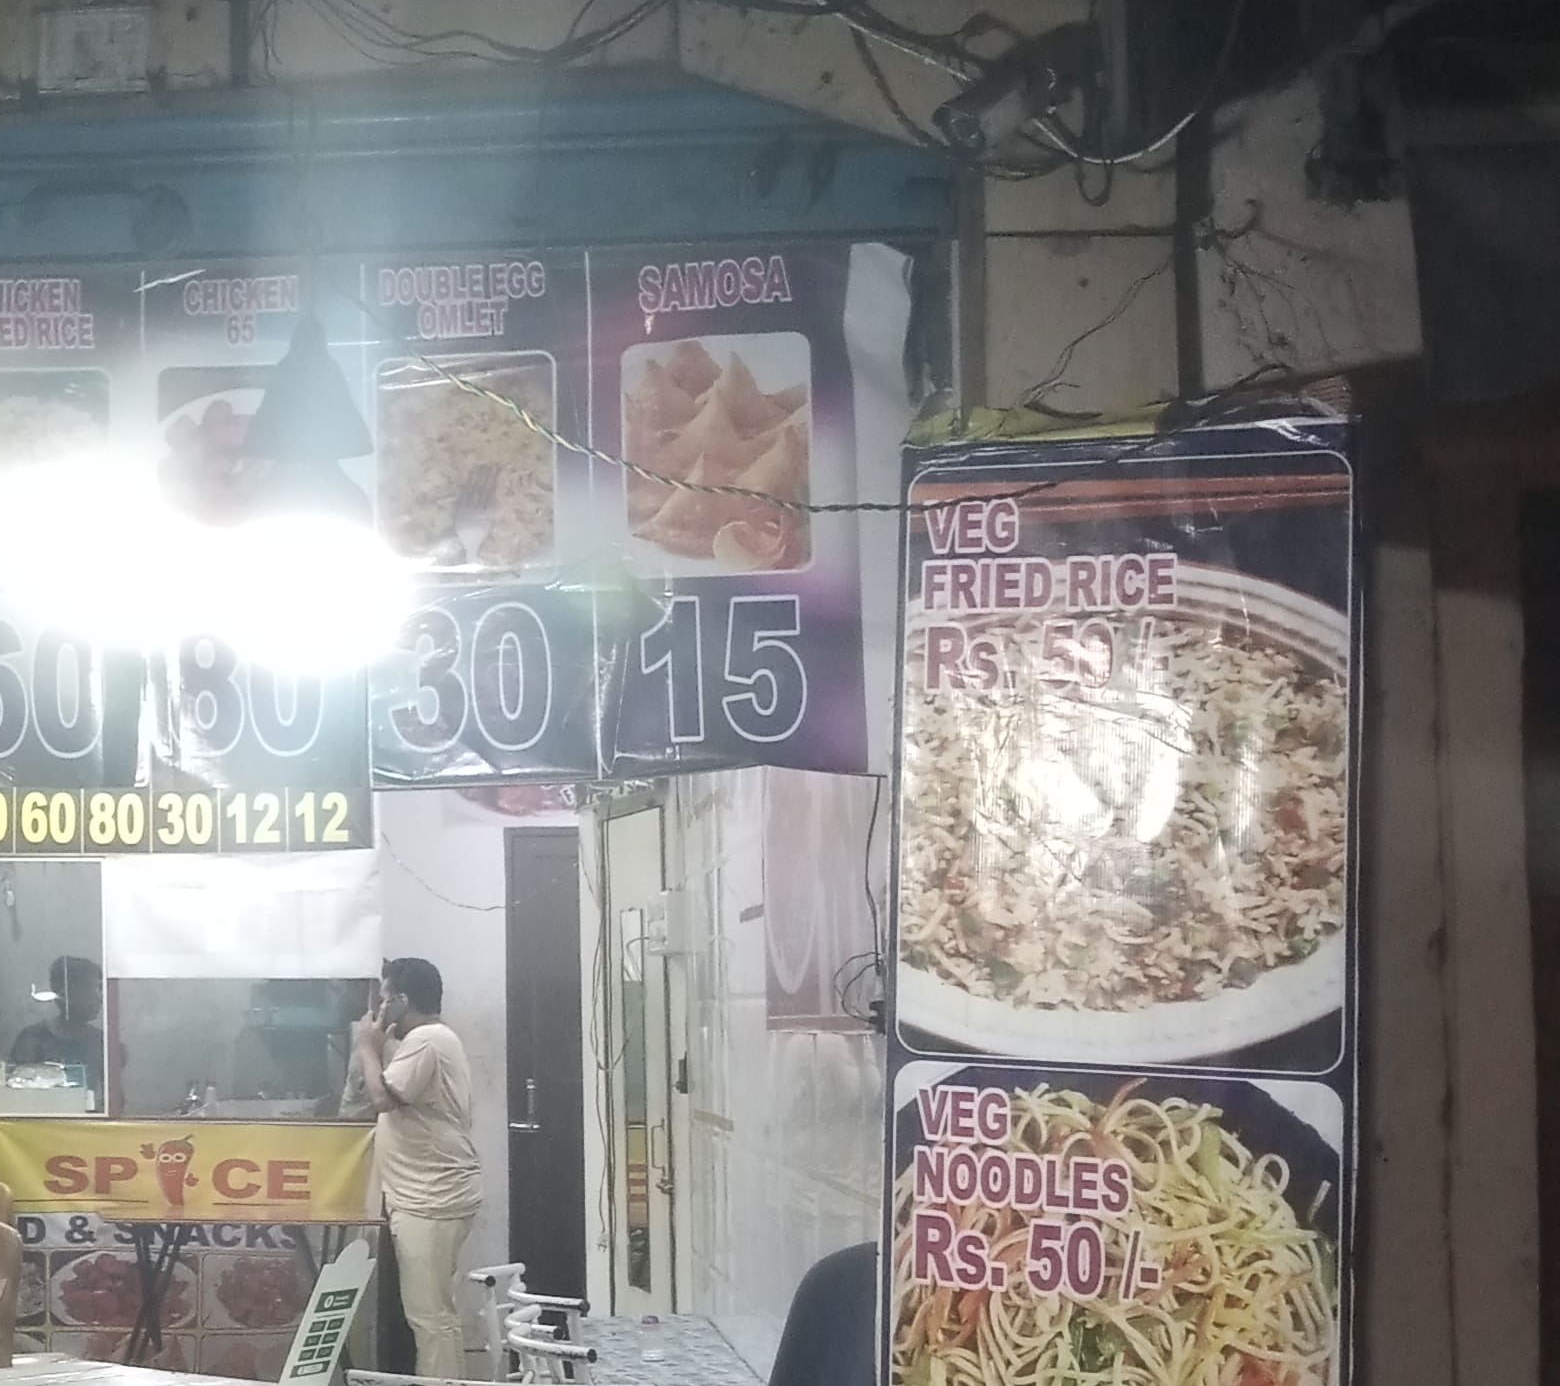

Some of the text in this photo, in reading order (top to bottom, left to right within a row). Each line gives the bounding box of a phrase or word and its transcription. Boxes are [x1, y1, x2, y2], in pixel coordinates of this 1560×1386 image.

[184, 275, 297, 314] CHICKEN
[378, 260, 546, 307] DOUBLE EGG
[639, 256, 792, 314] SAMOSA
[37, 312, 95, 349] RICE
[226, 313, 256, 345] 65
[417, 300, 507, 340] OMLET
[923, 498, 1020, 555] VEG
[921, 553, 1177, 613] FRIED RICE
[172, 630, 325, 758] 80
[387, 601, 552, 754] 30
[640, 594, 807, 744] 15
[20, 792, 76, 844] 60
[89, 793, 145, 845] 80
[157, 793, 213, 845] 30
[226, 793, 281, 844] 12
[295, 792, 350, 843] 12
[917, 1084, 1011, 1144] VEG
[913, 1146, 1132, 1214] NOODLES
[65, 1215, 97, 1245] &
[912, 1210, 1007, 1290] Rs.
[1027, 1219, 1107, 1299] 50
